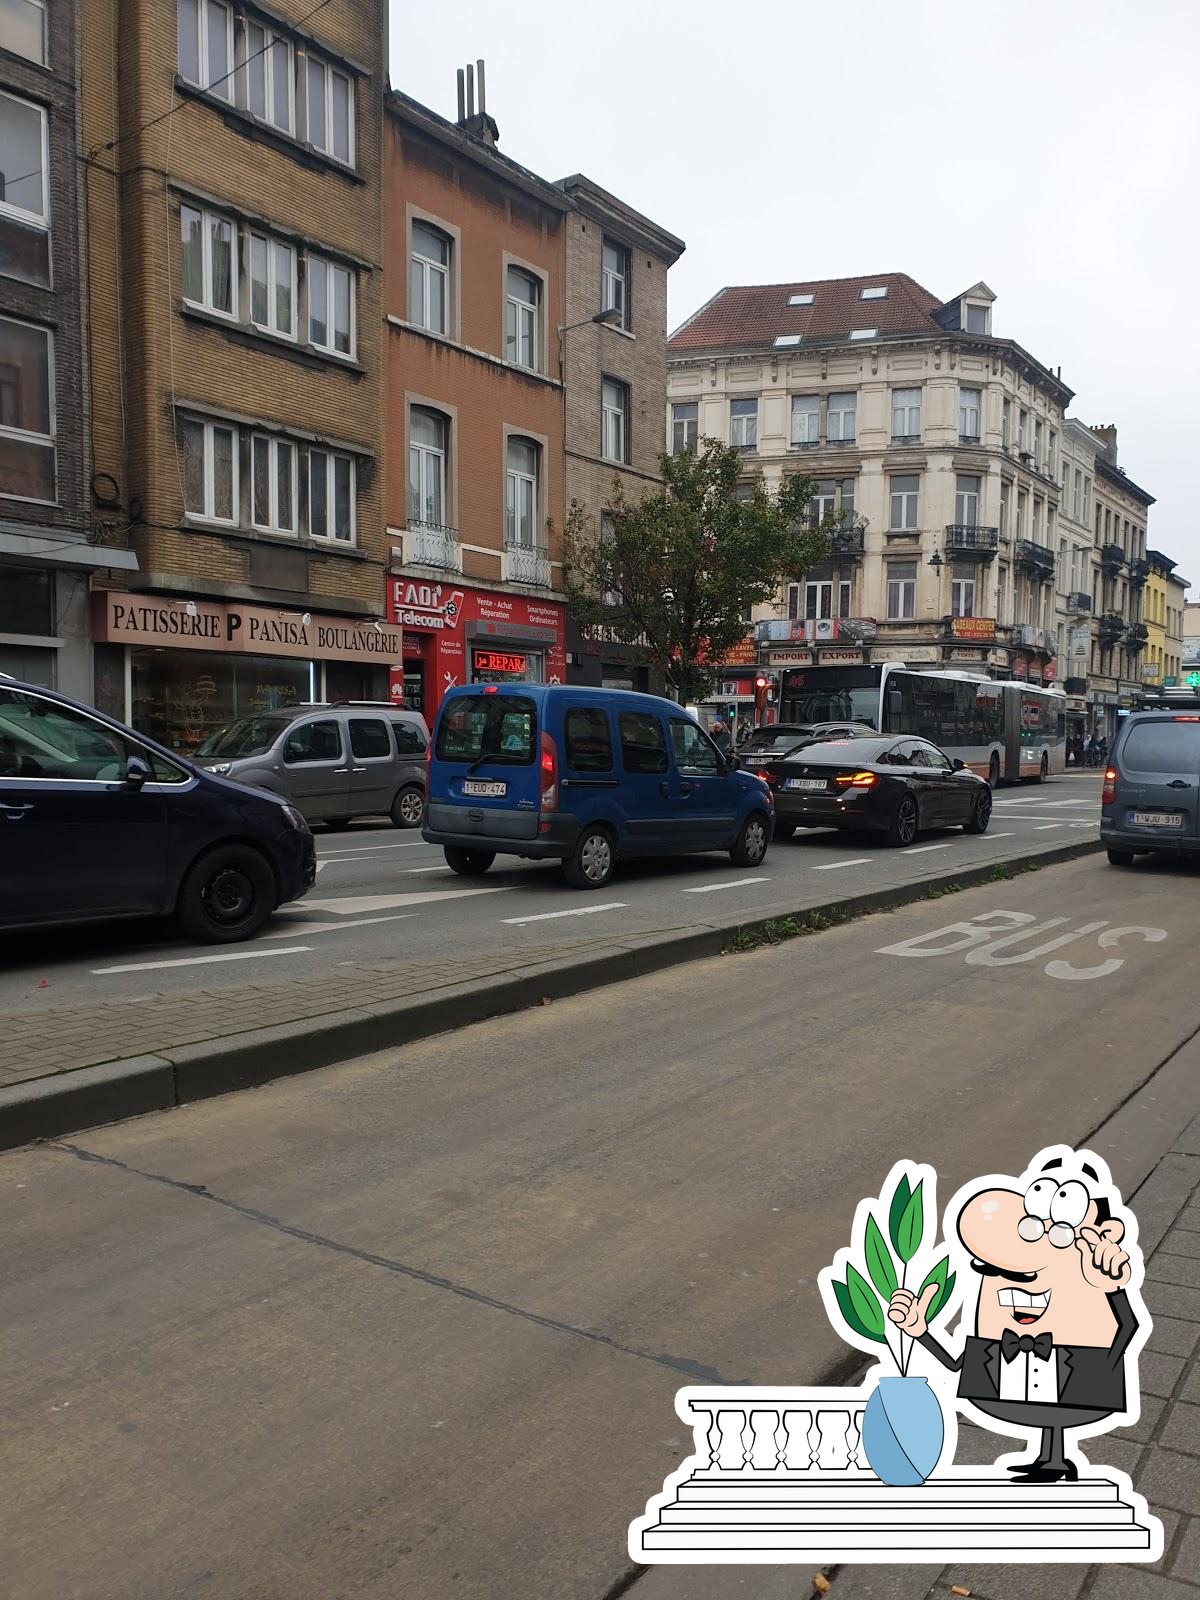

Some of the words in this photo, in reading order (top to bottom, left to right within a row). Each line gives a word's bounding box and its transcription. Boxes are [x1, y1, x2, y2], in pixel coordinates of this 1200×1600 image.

[477, 597, 493, 607] Vente
[497, 600, 513, 610] Achat
[480, 608, 509, 619] Réparation
[527, 605, 559, 617] Smartphones
[395, 608, 444, 629] Telecom
[529, 615, 558, 626] Ordinateurs
[112, 604, 220, 638] PATISSERIE
[226, 613, 242, 641] P
[249, 617, 308, 646] PANISA
[317, 626, 399, 655] BOULANGERIE
[773, 652, 809, 661] IMPORT
[822, 651, 861, 660] EXPORT
[1136, 815, 1181, 825] 1-WJU-915
[873, 909, 1168, 981] BUS
